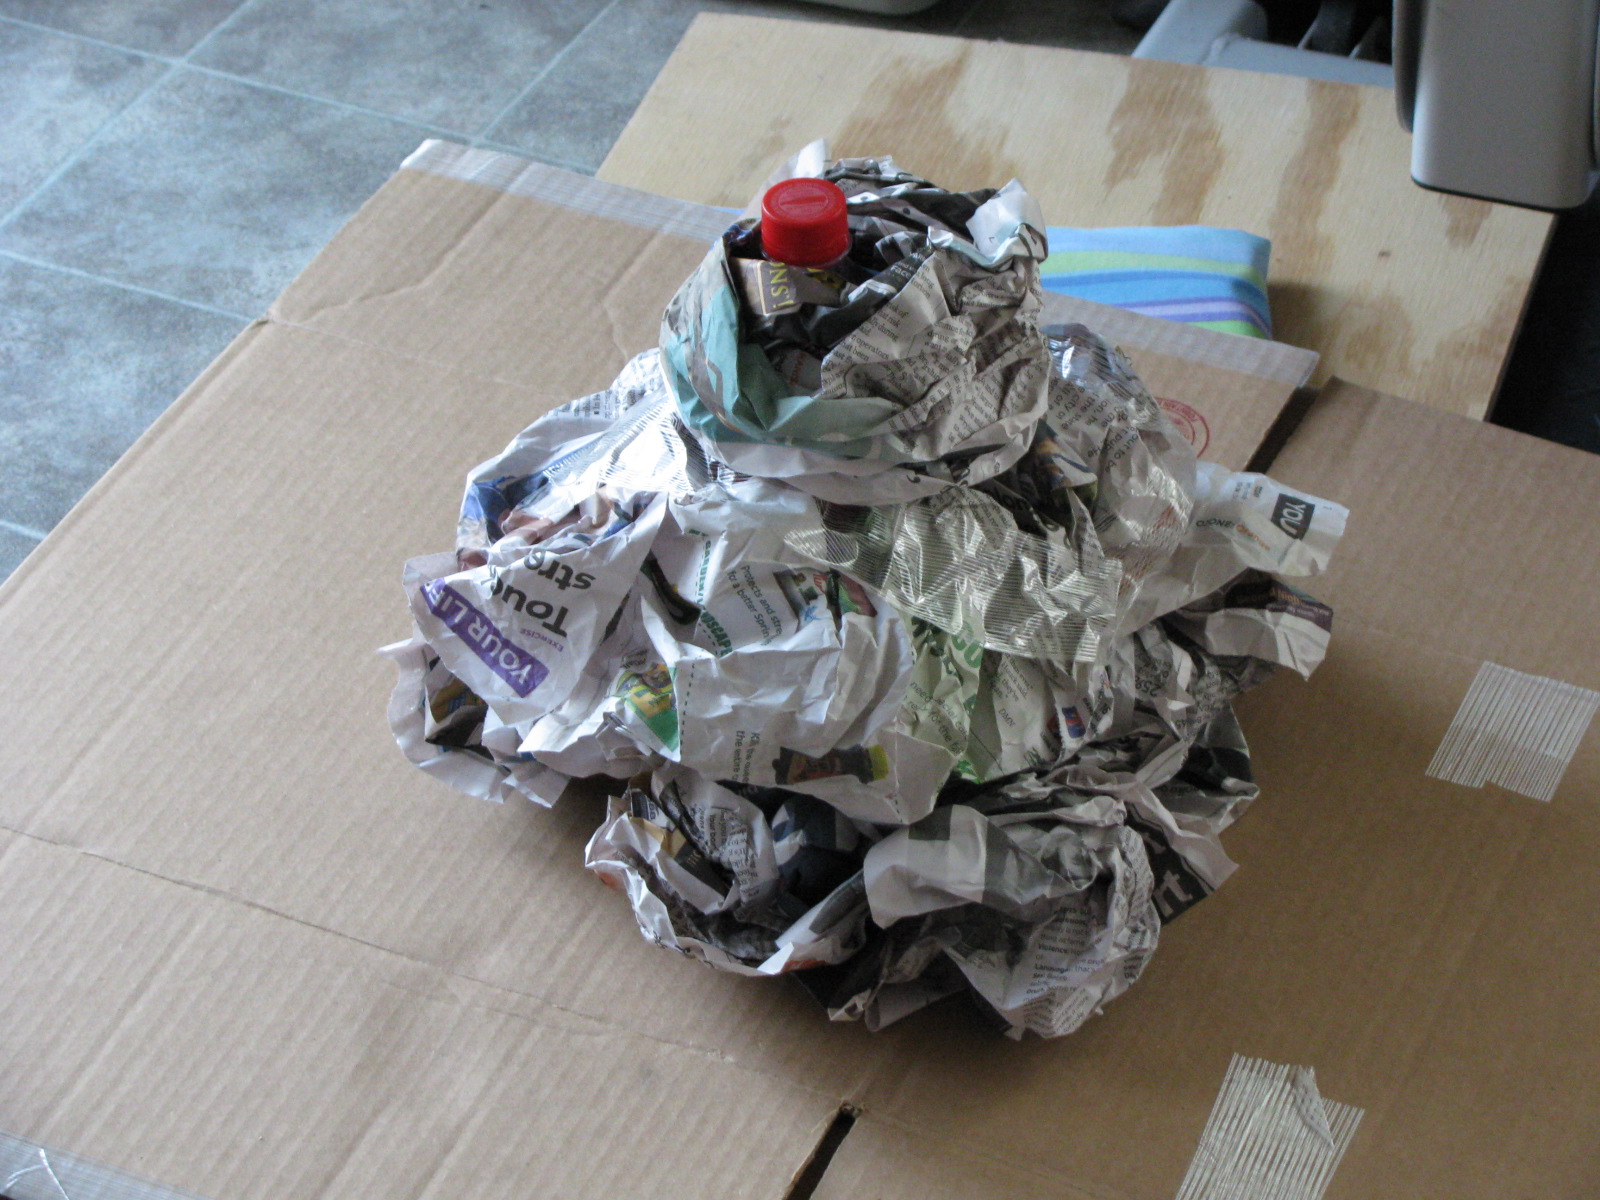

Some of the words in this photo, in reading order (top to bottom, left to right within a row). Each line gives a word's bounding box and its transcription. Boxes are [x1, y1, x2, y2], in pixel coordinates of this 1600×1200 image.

[855, 334, 891, 363] operators
[1280, 503, 1306, 535] YOU
[727, 570, 738, 582] for
[737, 589, 757, 613] better
[741, 565, 763, 597] Protects
[760, 599, 776, 615] and
[467, 615, 532, 685] YOUR
[519, 628, 564, 653] EXERCISE
[735, 730, 745, 747] the
